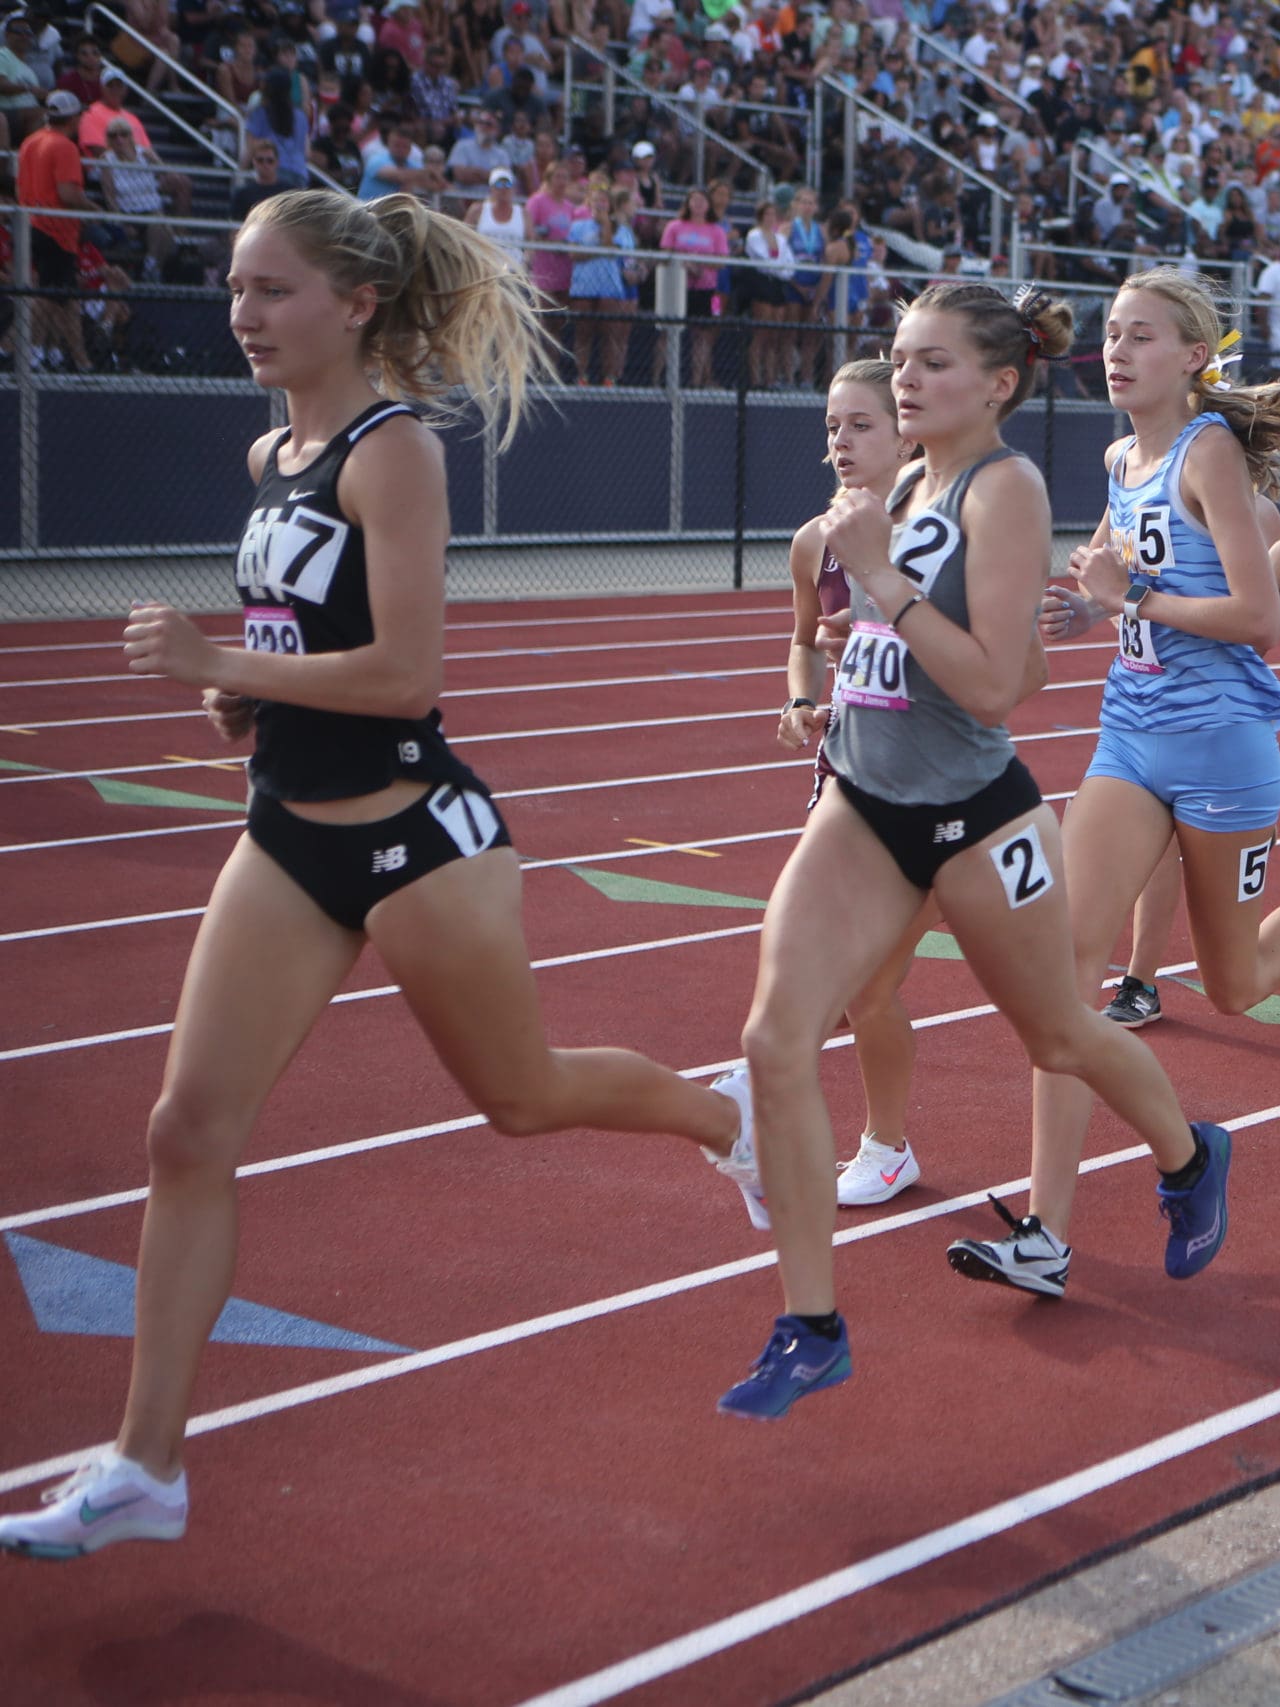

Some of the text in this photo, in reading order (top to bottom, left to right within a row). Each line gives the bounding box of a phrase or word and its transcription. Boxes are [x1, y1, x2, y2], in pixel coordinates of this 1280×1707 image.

[281, 515, 337, 588] 7
[897, 516, 949, 584] 2
[1139, 511, 1166, 566] 5
[841, 635, 899, 692] 410
[434, 784, 485, 849] 7
[1002, 838, 1046, 903] 2
[1243, 845, 1268, 895] 5
